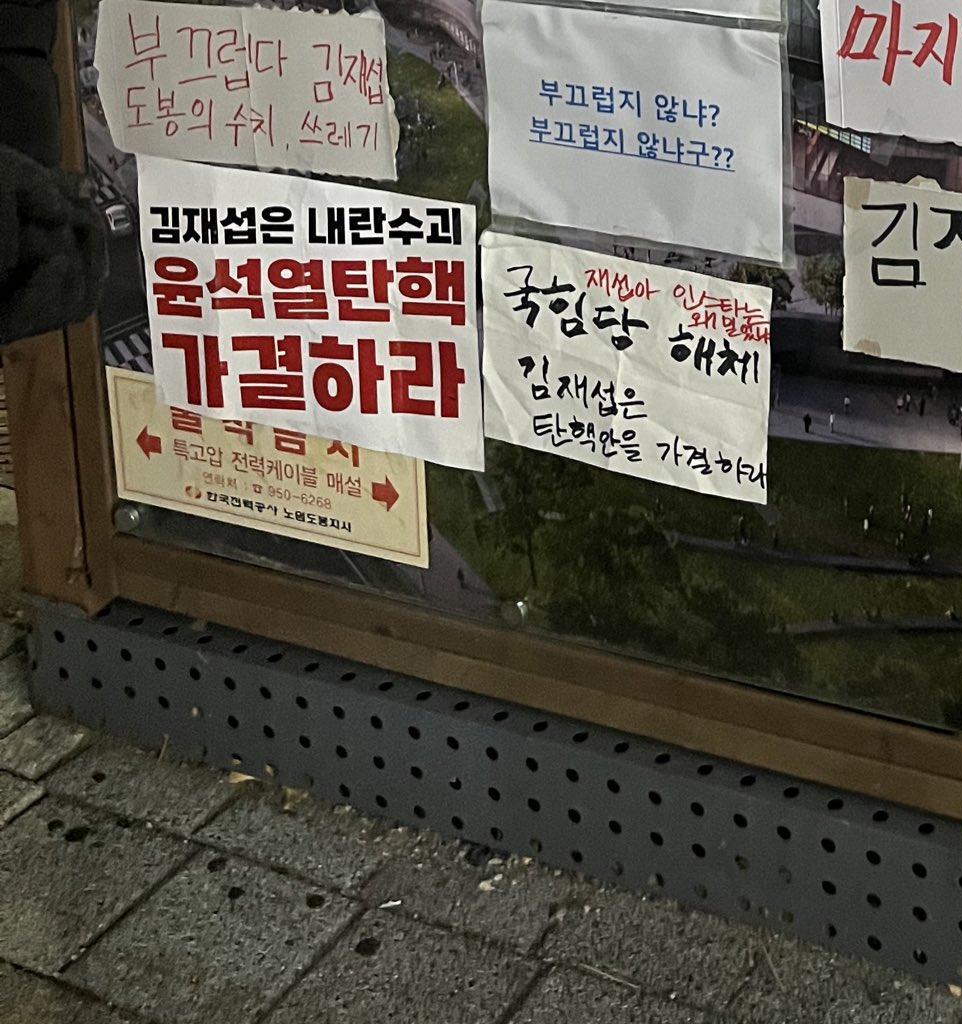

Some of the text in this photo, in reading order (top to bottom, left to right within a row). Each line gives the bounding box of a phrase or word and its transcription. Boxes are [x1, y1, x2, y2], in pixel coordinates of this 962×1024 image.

[125, 12, 385, 106] 부끄럽다 김재섭
[126, 85, 214, 142] 도봉의
[299, 109, 379, 152] 쓰레기
[538, 78, 722, 128] 부끄럽지 않냐?
[529, 116, 736, 170] 부끄럽지 않냐구??
[149, 205, 462, 246] 김재섭은 내란수괴
[503, 264, 760, 385] 국힘당 해체
[161, 332, 466, 419] 가결하라
[517, 354, 649, 420] 김재섭은
[172, 437, 224, 468] 특고압
[231, 450, 319, 489] 전력케이블
[325, 471, 363, 499] 매설
[533, 412, 643, 463] 탄핵안을
[267, 483, 333, 511] 950-6268
